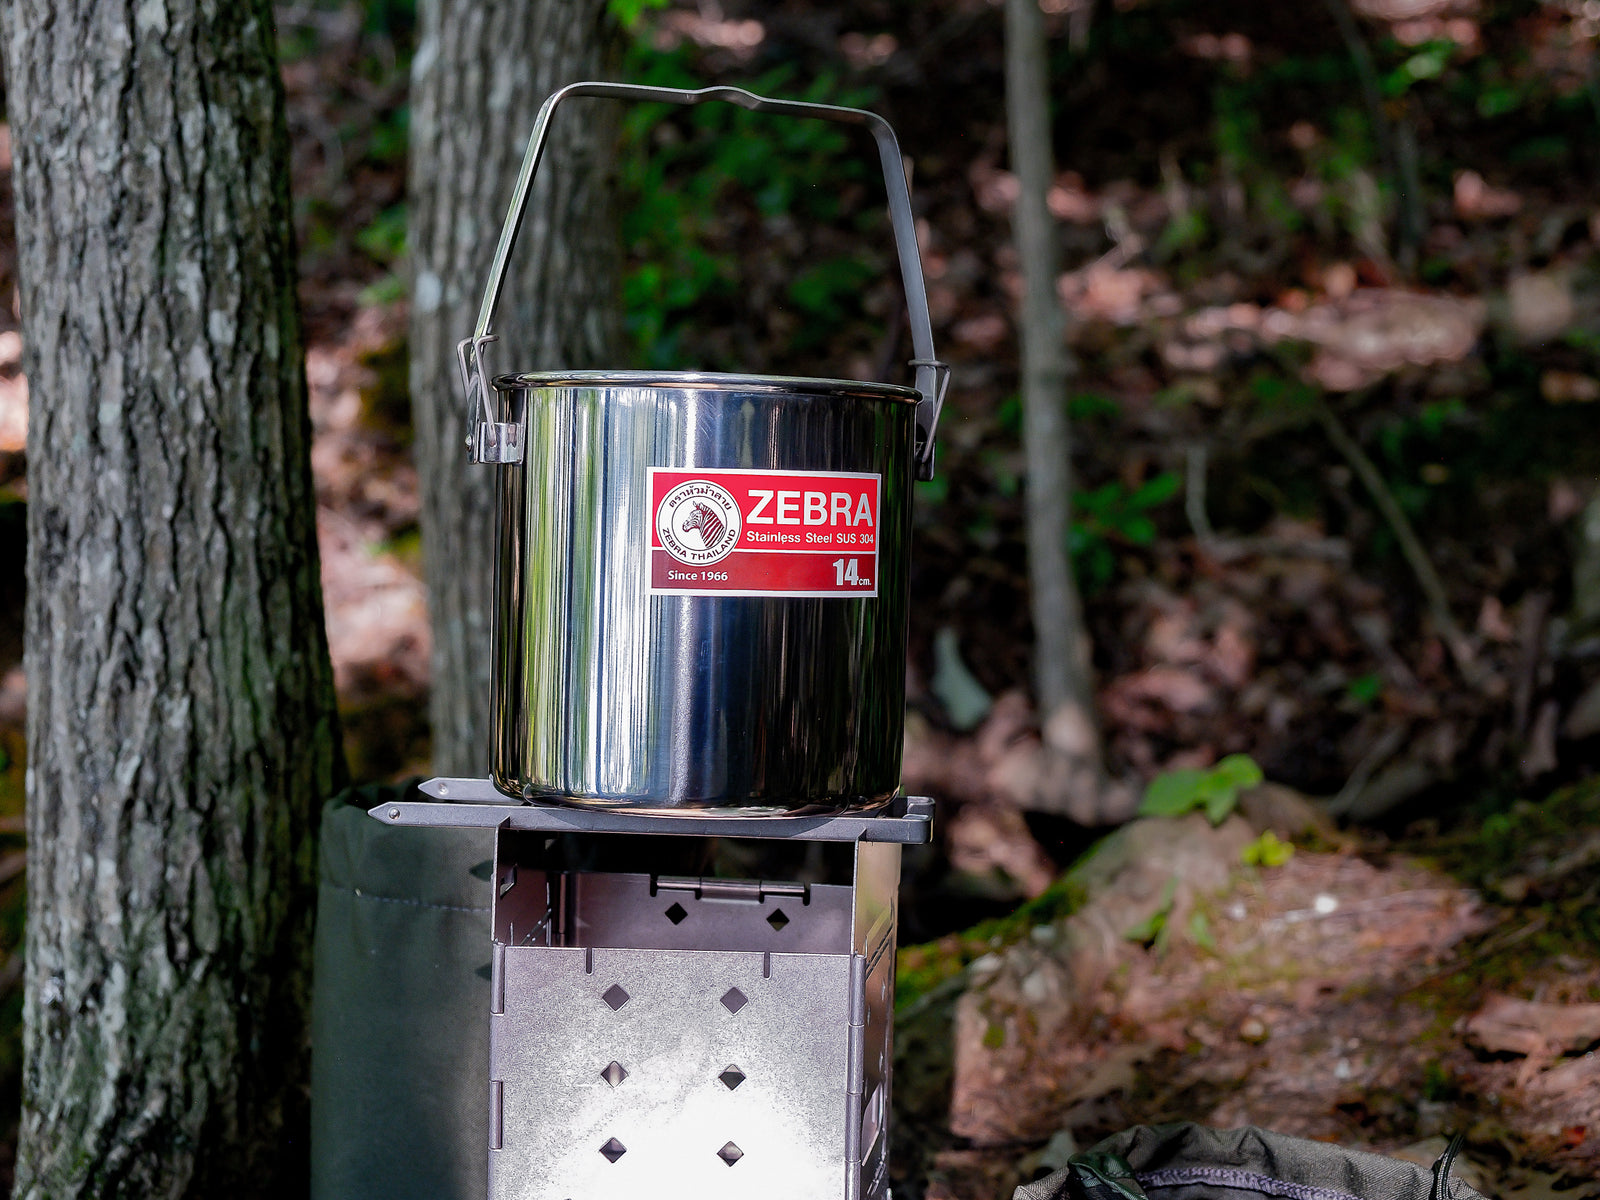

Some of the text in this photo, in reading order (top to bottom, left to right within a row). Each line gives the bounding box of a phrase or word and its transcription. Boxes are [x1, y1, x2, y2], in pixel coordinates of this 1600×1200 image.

[746, 489, 874, 527] ZEBRA
[662, 527, 736, 561] ZEBRA THAILAND
[746, 530, 874, 544] Stainless Steel SUS 304
[668, 570, 728, 581] Since 1966
